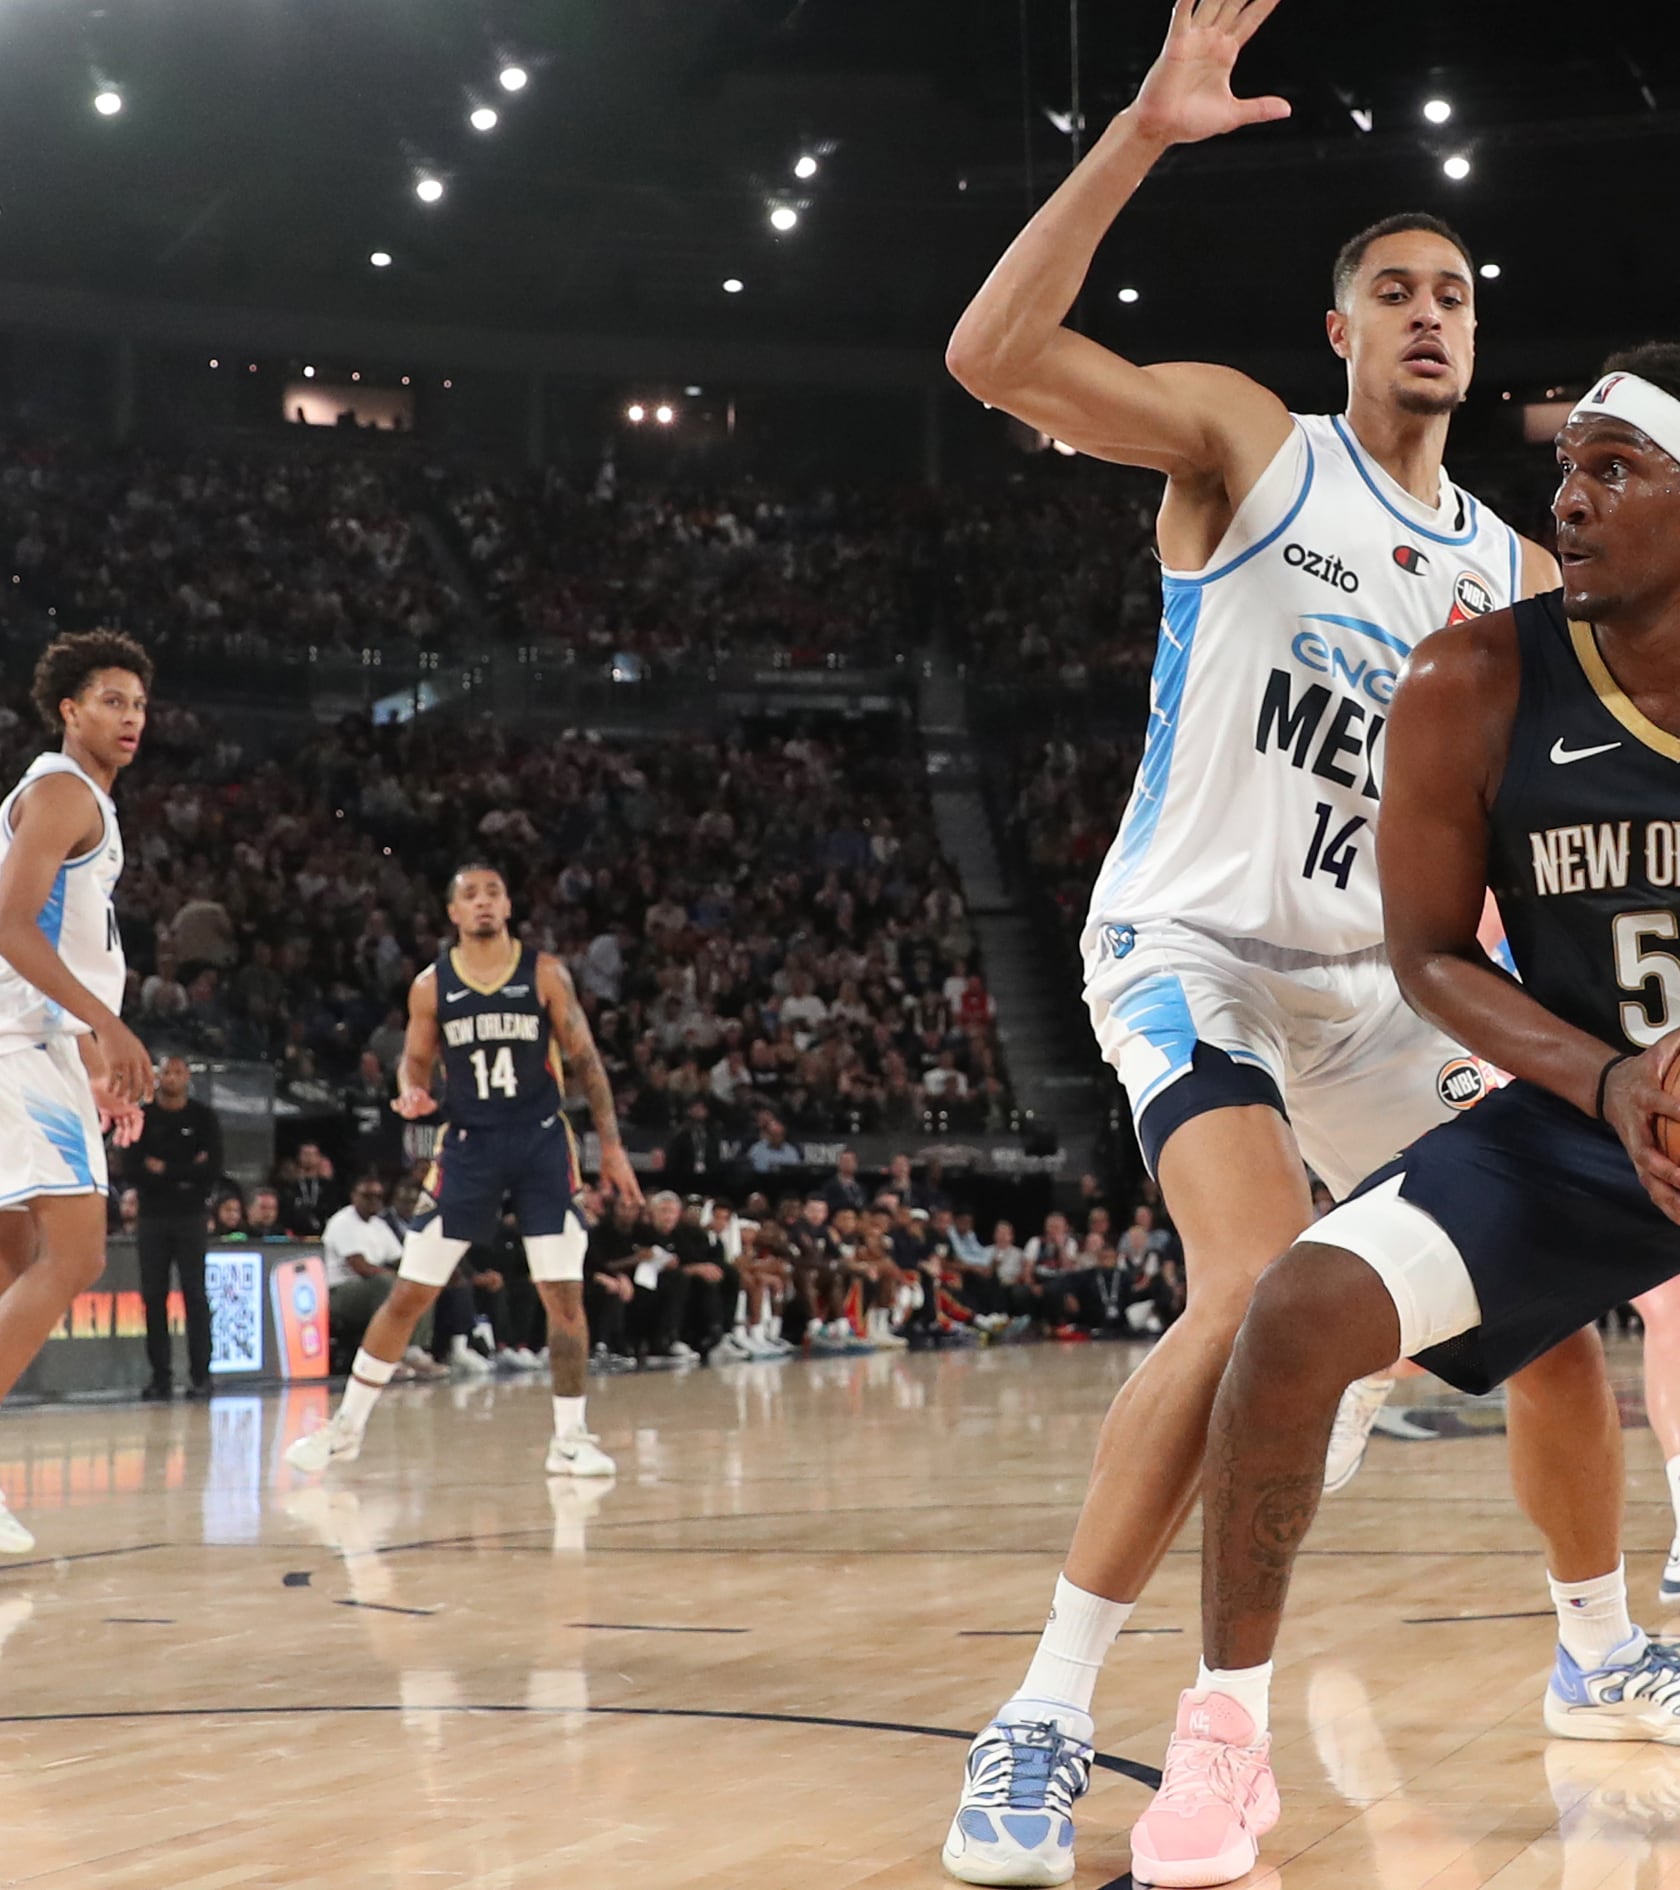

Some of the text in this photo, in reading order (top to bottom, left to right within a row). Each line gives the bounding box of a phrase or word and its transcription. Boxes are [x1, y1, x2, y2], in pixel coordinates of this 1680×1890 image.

[1283, 543, 1359, 593] ozito
[1461, 580, 1487, 612] NBL
[1302, 801, 1368, 891] 14
[1529, 821, 1631, 896] NEW
[476, 1012, 540, 1042] ORLEANS
[469, 1046, 518, 1100] 14
[1446, 1069, 1480, 1100] NBL
